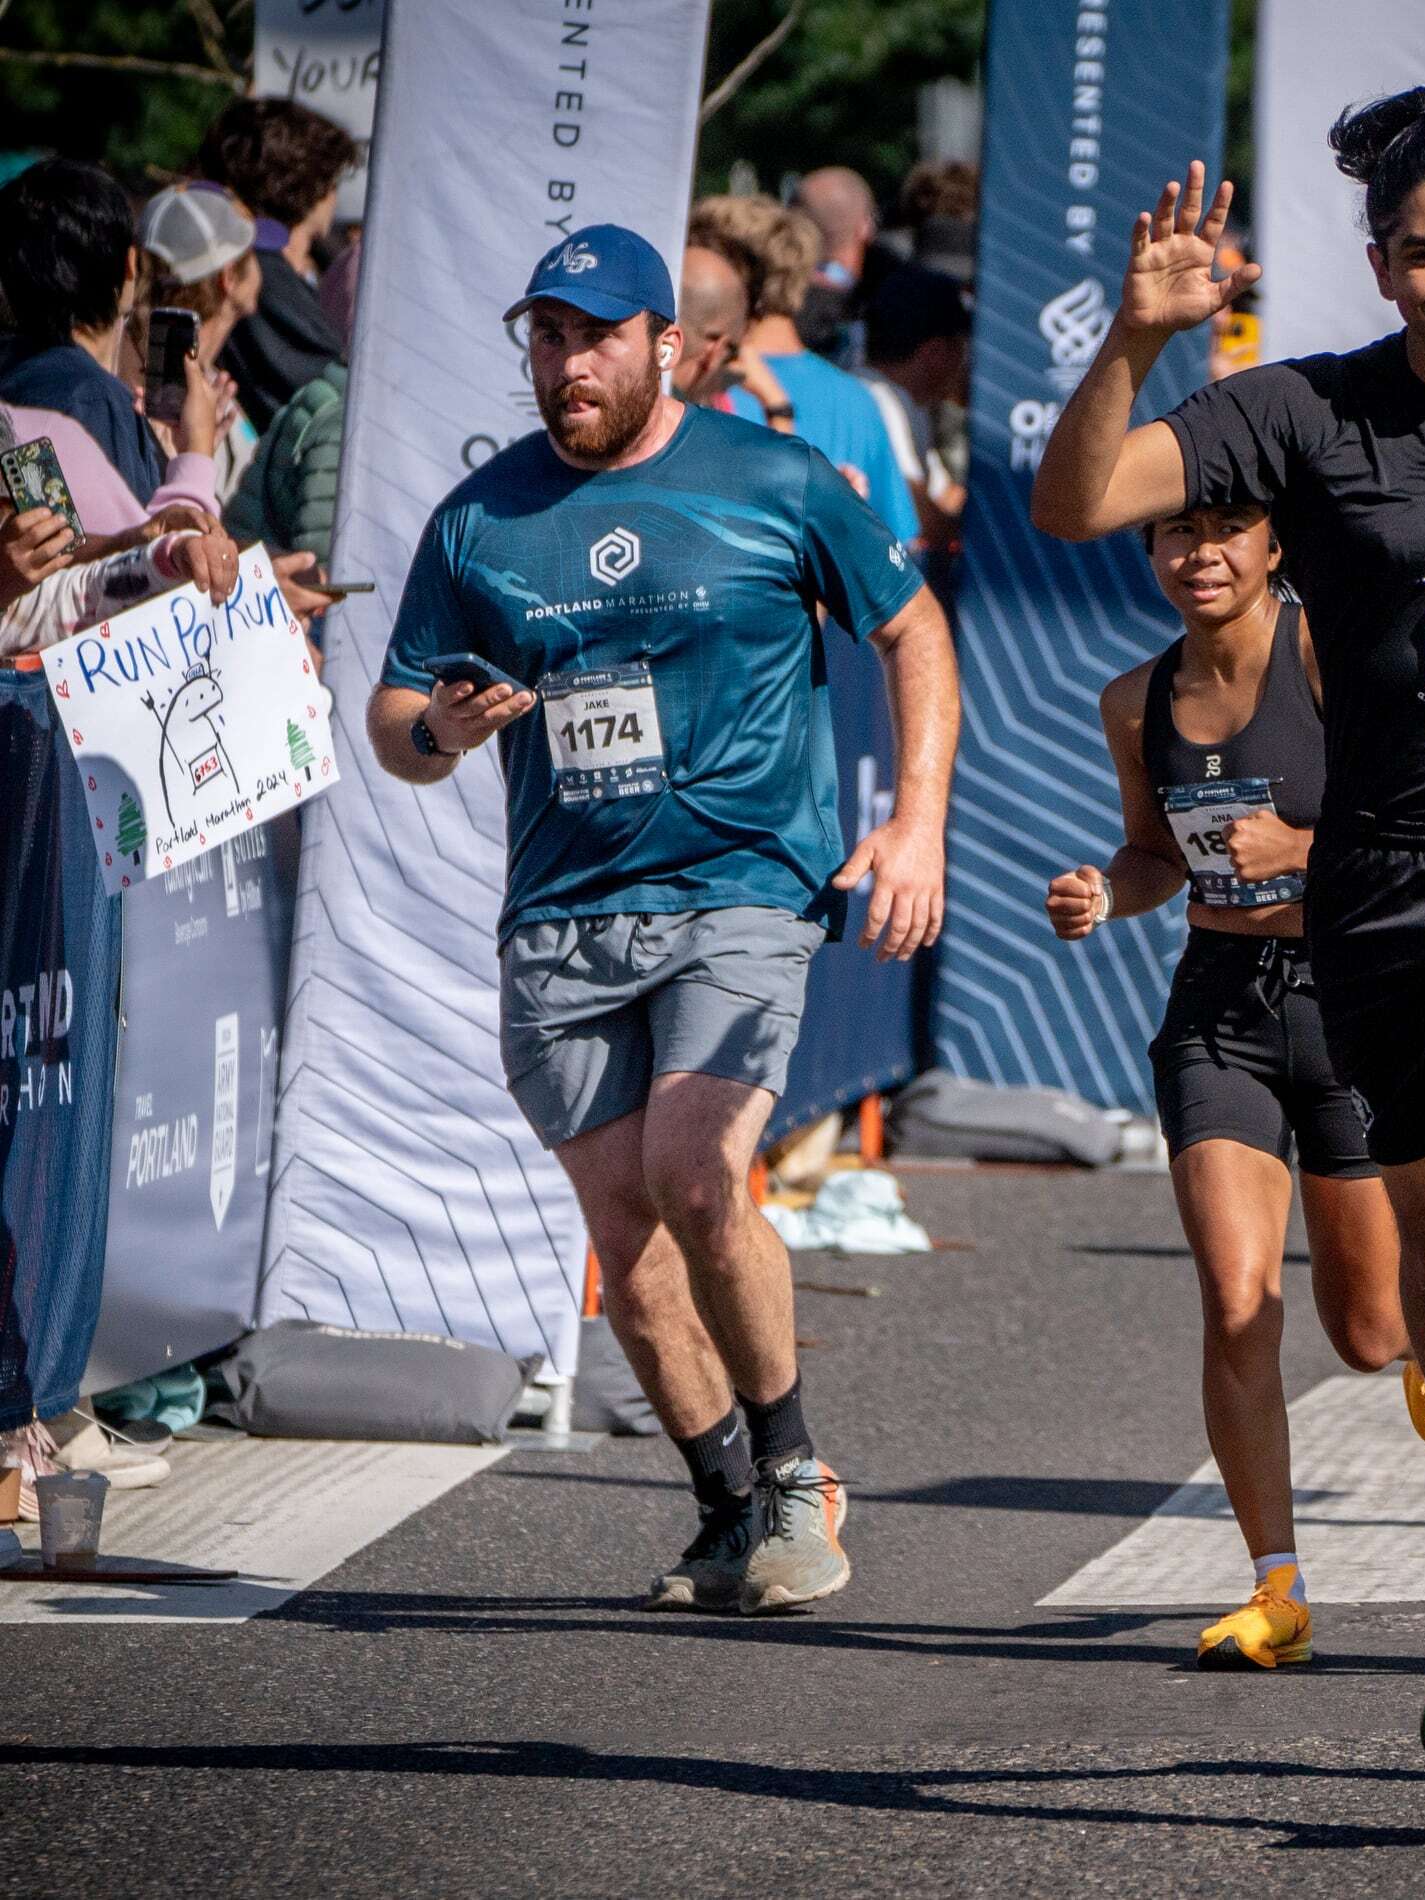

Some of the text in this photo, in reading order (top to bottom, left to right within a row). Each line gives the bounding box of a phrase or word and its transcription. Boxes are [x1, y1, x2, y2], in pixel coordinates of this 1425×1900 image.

[545, 180, 576, 237] BY
[1065, 206, 1097, 256] BY
[525, 590, 689, 621] PORTLAND MARATHON
[629, 604, 674, 615] PRESENTED
[76, 626, 172, 693] RUN
[584, 699, 610, 711] JAKE
[560, 712, 644, 753] 1174
[155, 769, 289, 854] Portland Marathon 2024
[1211, 813, 1234, 824] ANA
[1186, 830, 1229, 857] 18
[126, 1112, 198, 1190] PORTLAND
